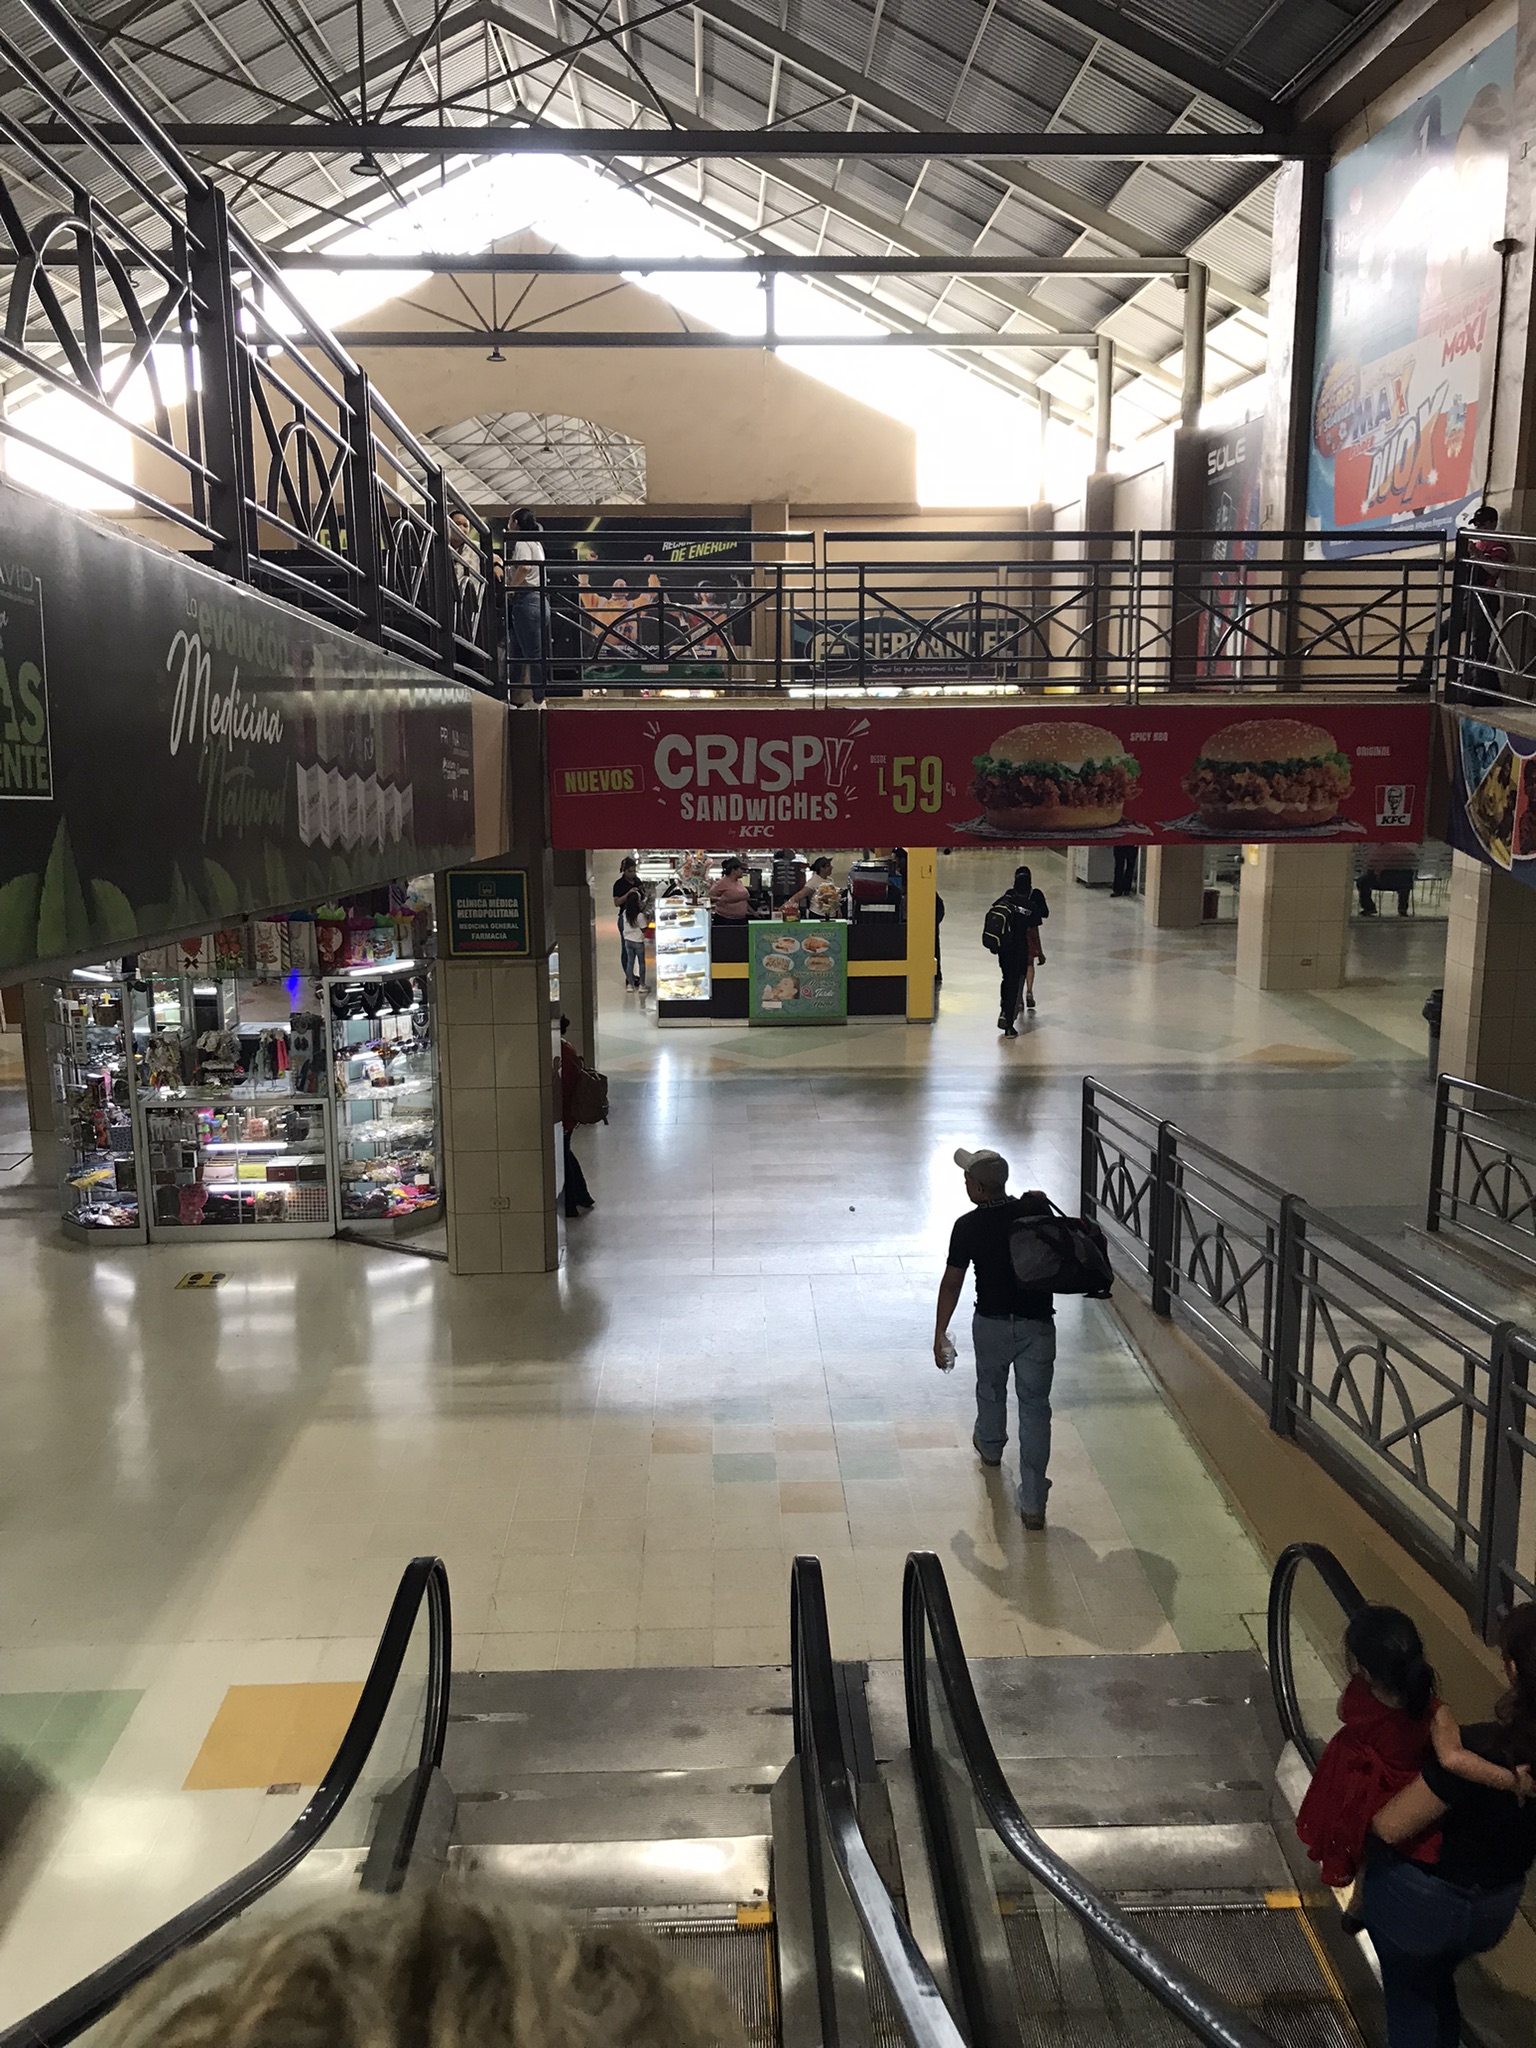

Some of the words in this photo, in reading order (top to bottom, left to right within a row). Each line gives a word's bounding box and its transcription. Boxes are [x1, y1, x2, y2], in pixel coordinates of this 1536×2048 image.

[670, 547, 687, 562] DE
[165, 629, 285, 757] Medicina
[1129, 731, 1153, 742] SPICY
[1356, 745, 1392, 757] ORIGINAL
[653, 733, 855, 792] CRISPY
[869, 754, 887, 764] DESDE
[564, 768, 635, 793] NUEVOS
[680, 791, 839, 821] SANDWICHES
[1381, 815, 1406, 825] KFC
[738, 825, 775, 838] KFC
[457, 897, 488, 908] CLÍNICA
[488, 897, 519, 908] MÉDICA
[457, 909, 519, 918] METROPOLITANA
[471, 932, 508, 940] FARMACIA
